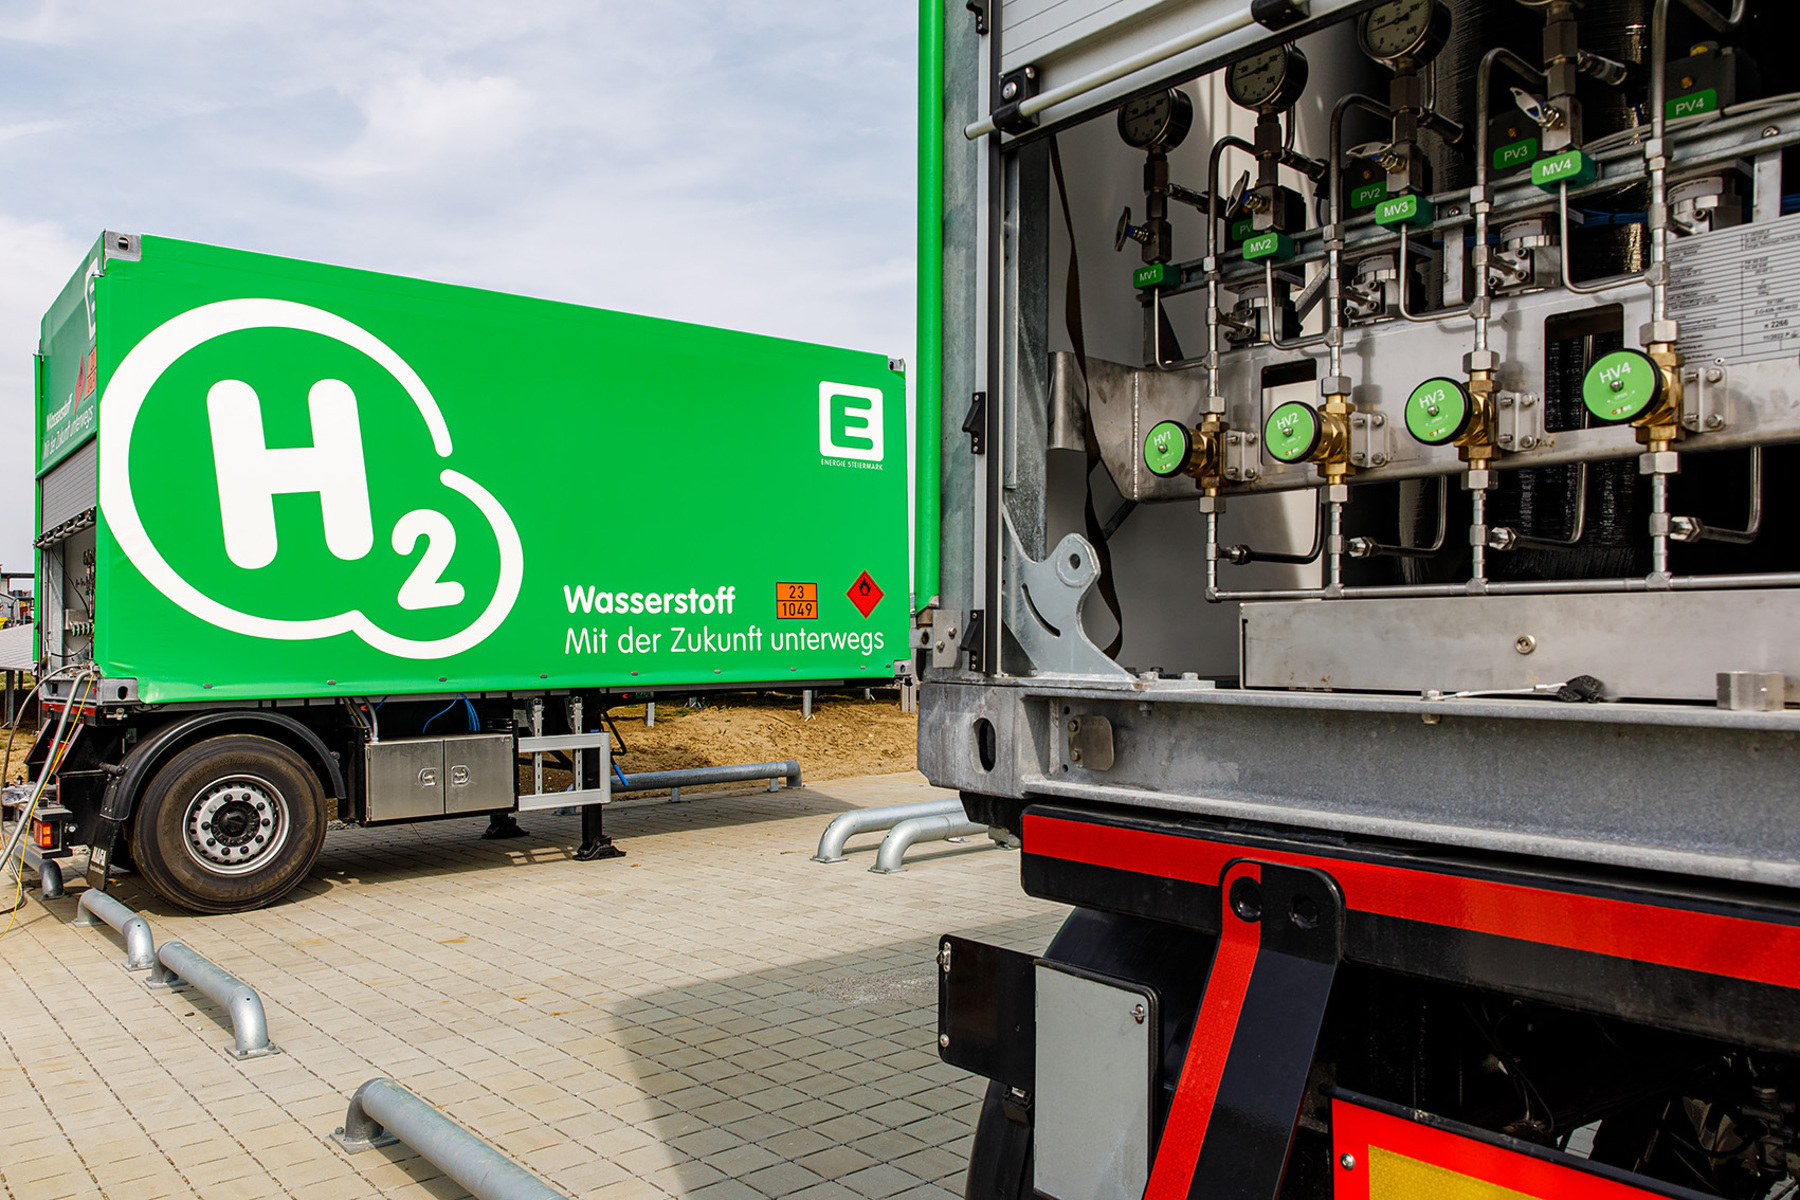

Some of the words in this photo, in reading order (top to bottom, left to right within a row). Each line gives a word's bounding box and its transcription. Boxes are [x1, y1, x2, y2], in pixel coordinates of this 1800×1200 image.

[1676, 97, 1704, 116] PV4
[1504, 145, 1529, 162] PV3
[1542, 158, 1572, 177] MV4
[1360, 187, 1381, 202] PV2
[1384, 201, 1409, 218] MV3
[1239, 223, 1254, 235] PV
[1250, 238, 1272, 253] MV2
[1139, 269, 1157, 282] MV1
[1599, 361, 1631, 384] HV4
[1419, 389, 1445, 409] HV3
[1276, 412, 1299, 430] HV2
[1153, 431, 1171, 446] HV1
[821, 458, 846, 467] ENERGIE
[847, 461, 884, 471] STEIERMARK
[563, 584, 736, 614] Wasserstoff
[789, 585, 804, 599] 23
[782, 602, 812, 616] 1049
[564, 627, 608, 655] Mit
[617, 625, 662, 654] der
[670, 625, 763, 653] Zukunft
[770, 627, 885, 656] unterwegs
